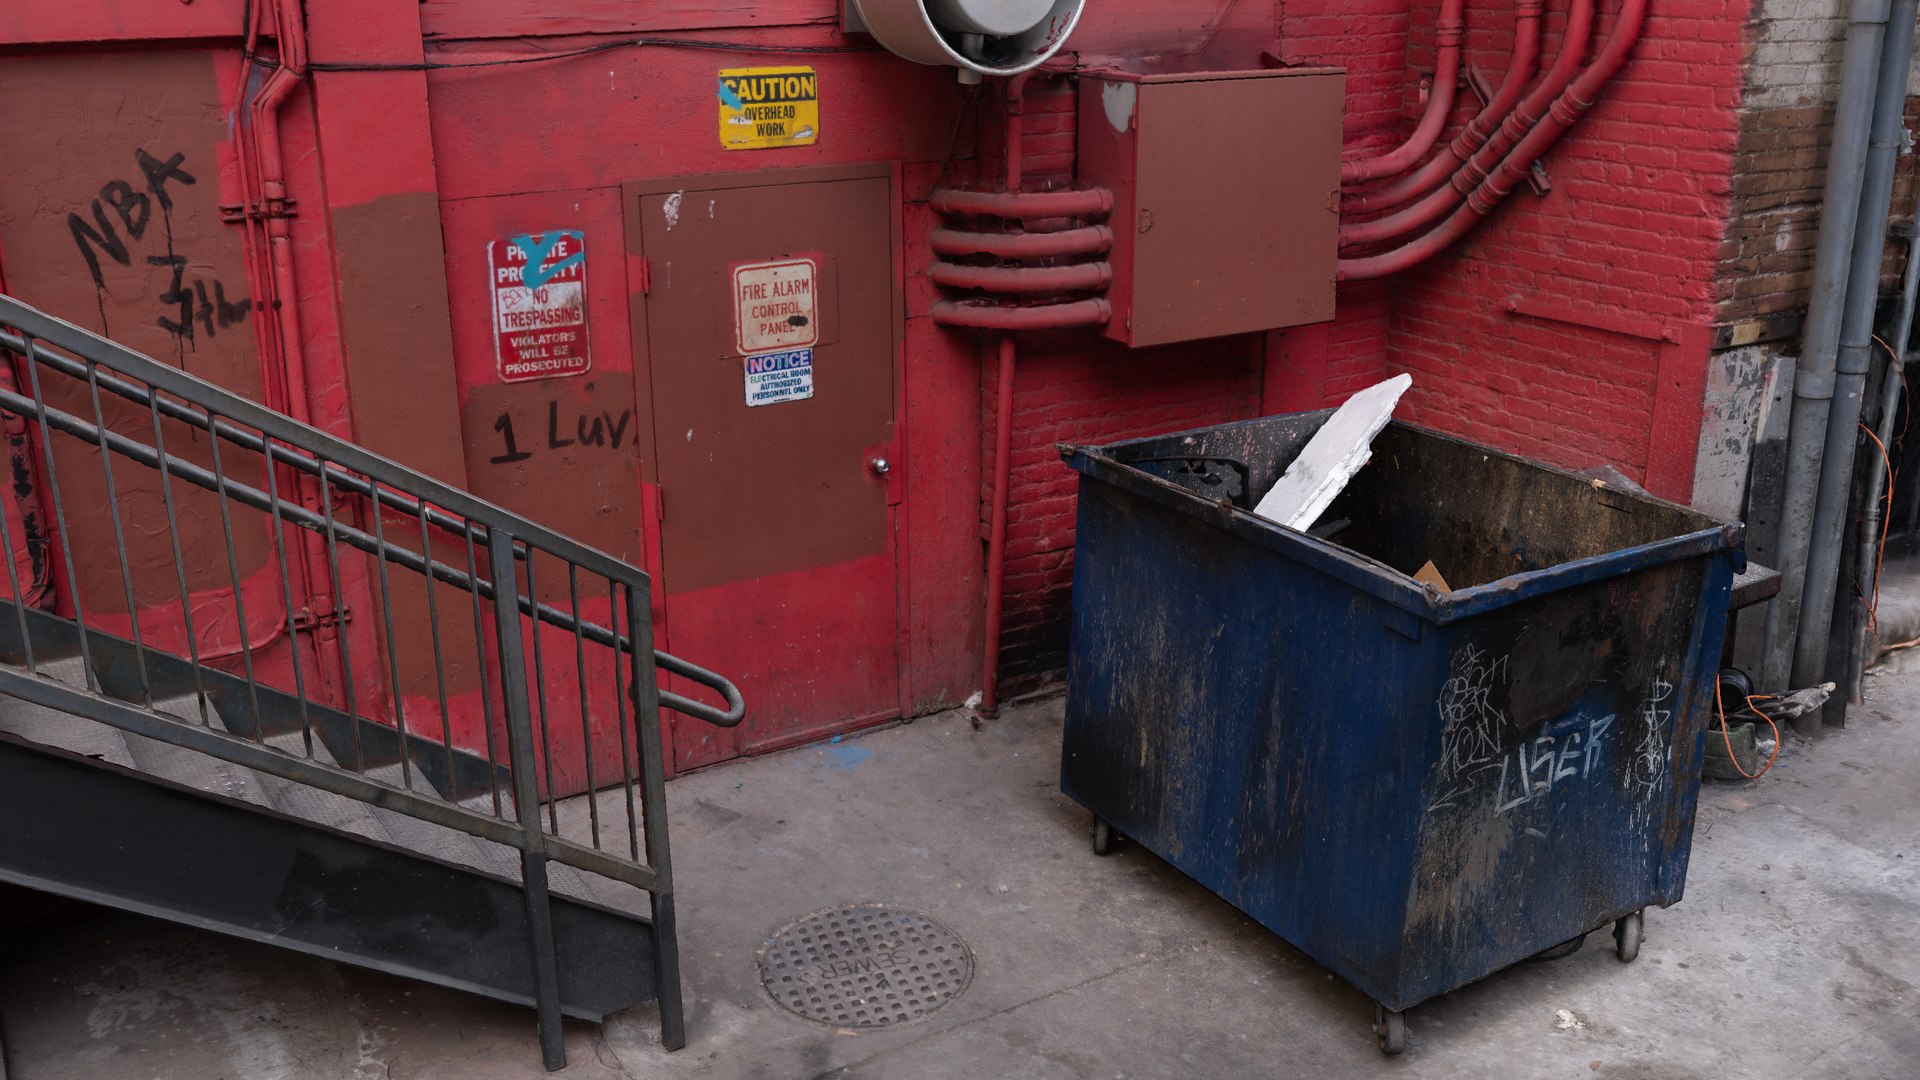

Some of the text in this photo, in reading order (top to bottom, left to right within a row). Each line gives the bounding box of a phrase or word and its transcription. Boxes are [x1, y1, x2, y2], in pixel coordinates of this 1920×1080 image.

[745, 105, 795, 121] OVERHEAD
[756, 122, 785, 137] WORK
[67, 147, 197, 294] NBA
[533, 288, 549, 304] NO
[742, 278, 810, 301] FIRE ALARM
[502, 307, 581, 328] TRESPASSING
[751, 301, 802, 319] CONTROL
[510, 331, 576, 348] VIOLATORS
[519, 345, 569, 360] WILL BE
[505, 357, 584, 374] PROSECUTED
[750, 350, 810, 374] NOTICE
[750, 367, 811, 384] ELECTRICAL ROOM
[752, 388, 792, 401] PERSONNEL
[793, 385, 811, 394] ONLY
[760, 378, 802, 391] AUTHORIZED
[489, 411, 533, 465] 1
[816, 949, 912, 980] SEWER
